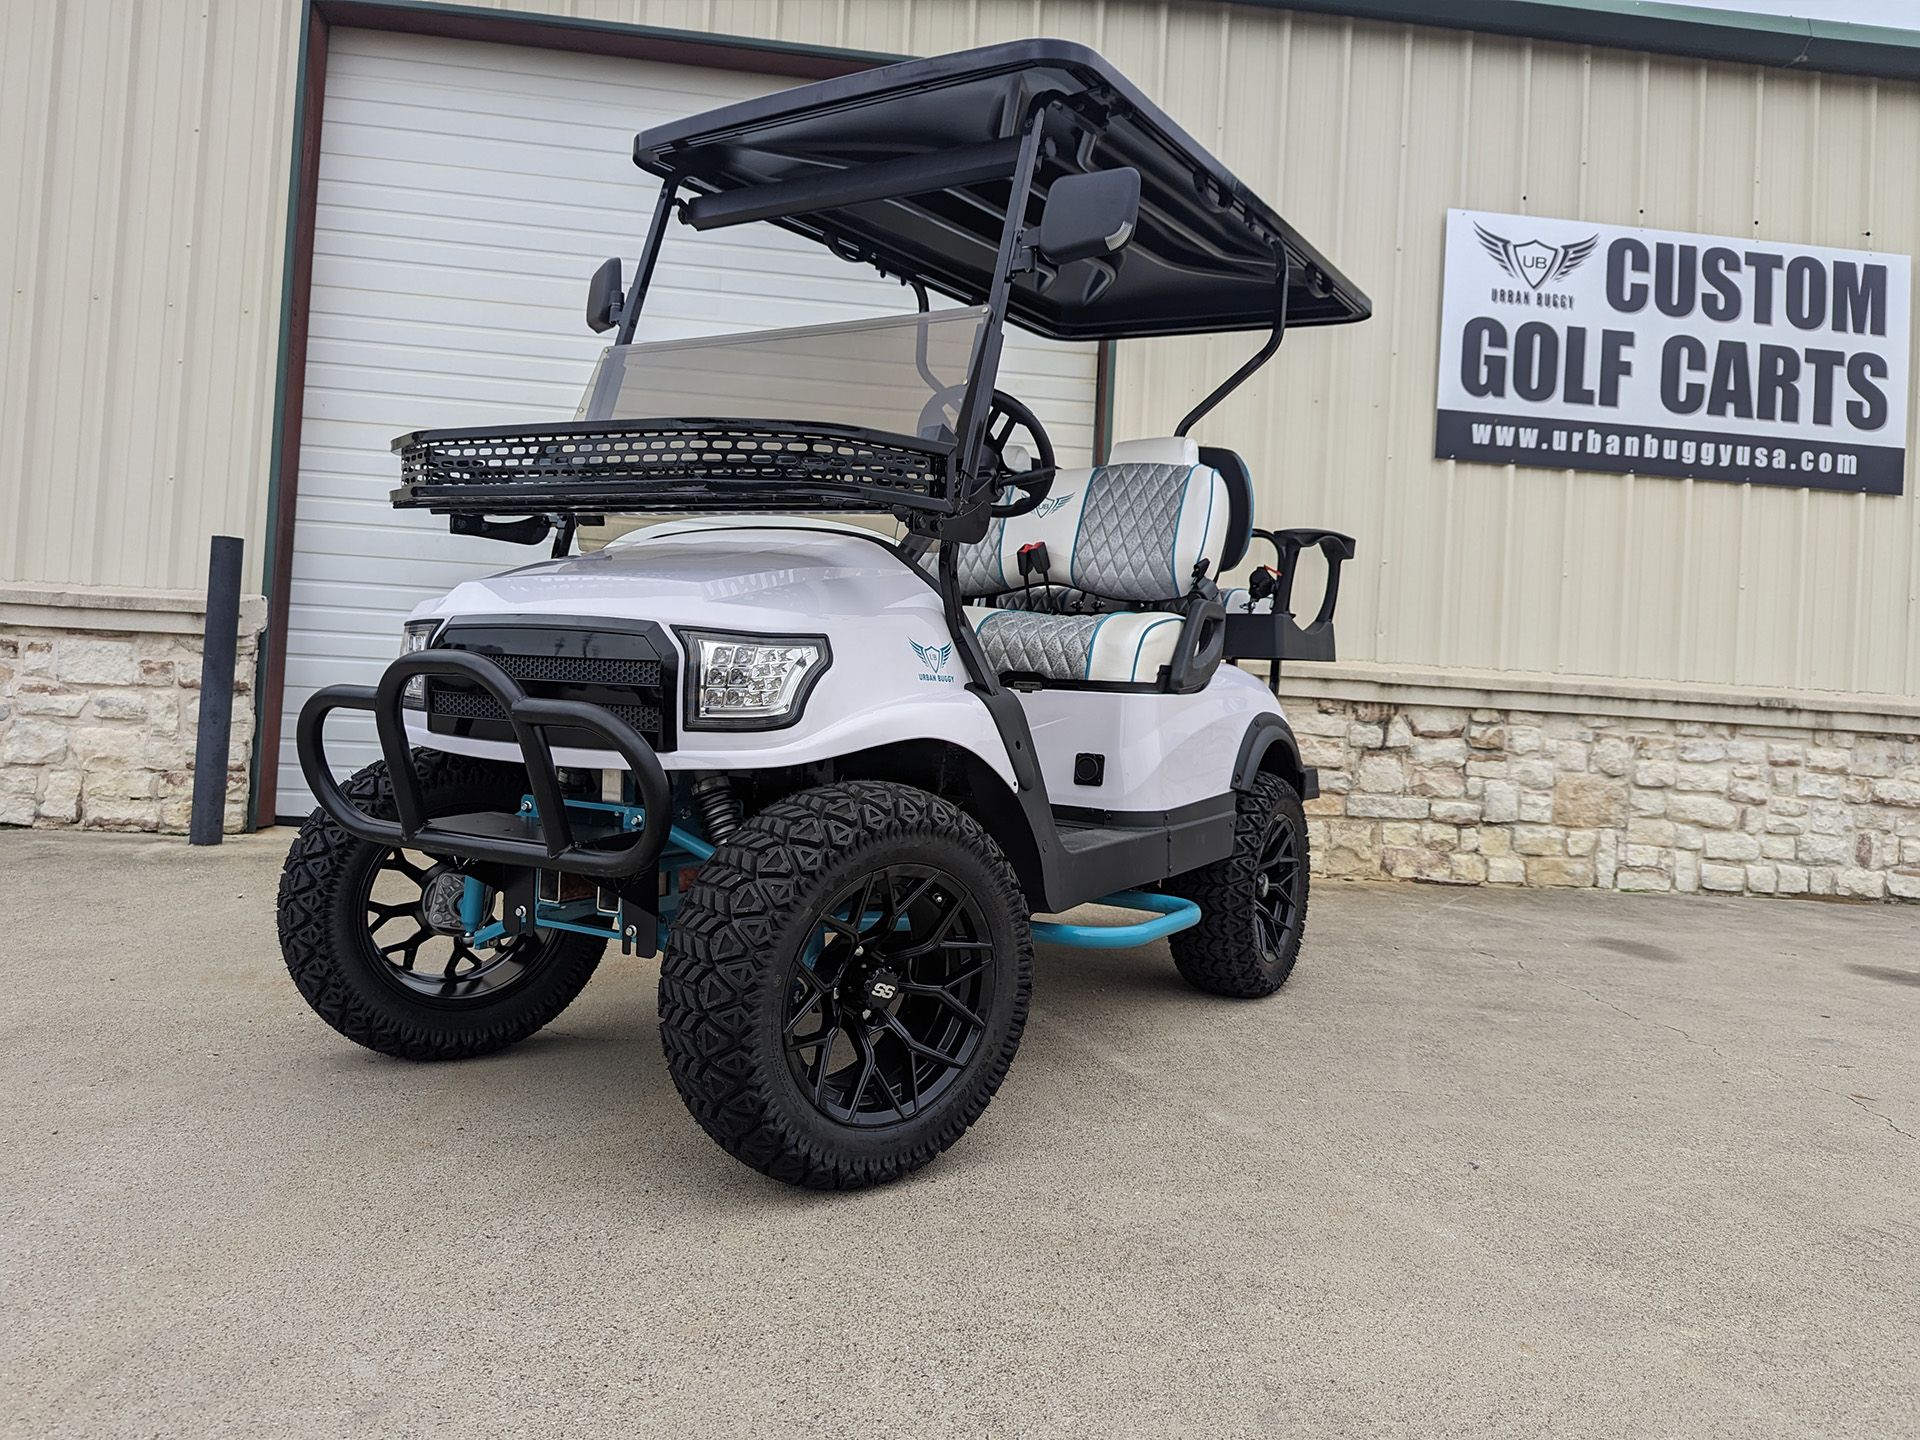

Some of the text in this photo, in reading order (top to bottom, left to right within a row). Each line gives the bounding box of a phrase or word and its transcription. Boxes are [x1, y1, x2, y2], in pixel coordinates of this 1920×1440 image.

[1523, 255, 1548, 270] UB
[1606, 237, 1888, 337] CUSTOM
[1491, 288, 1575, 310] URBAN BUGGY
[1461, 316, 1889, 431] GOLF CARTS
[1471, 422, 1858, 475] www.urbanbuggyusa.com
[918, 673, 955, 682] URBAN BUGGY
[871, 982, 896, 999] SS
